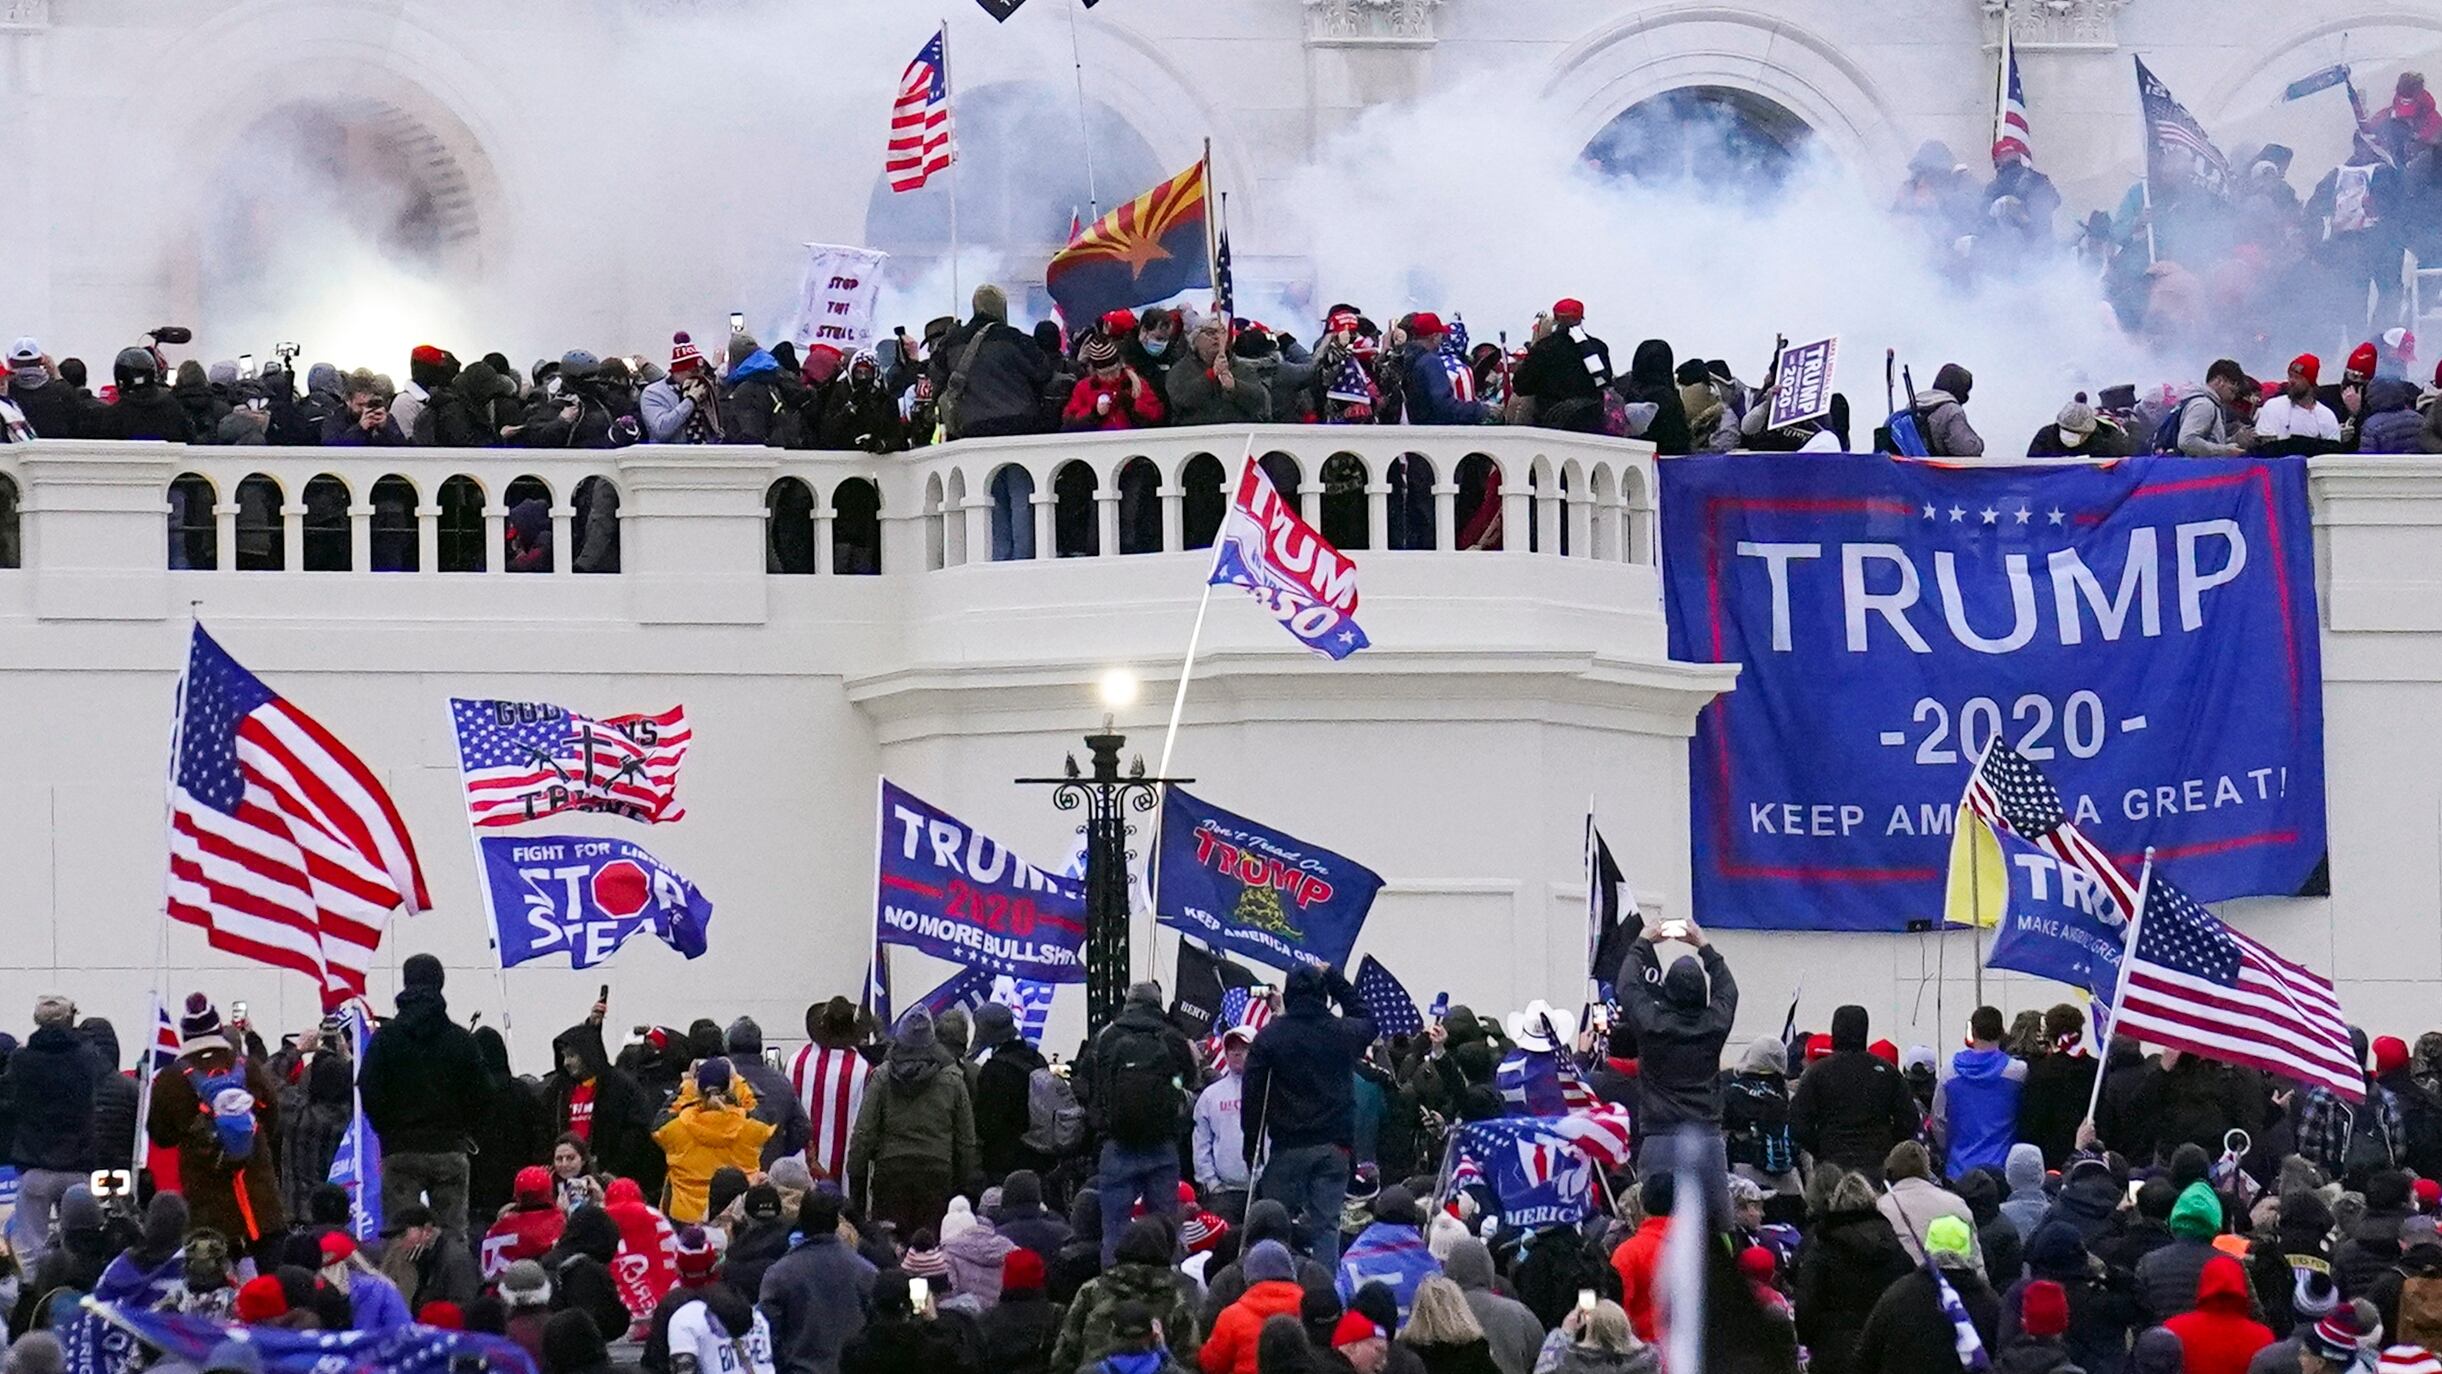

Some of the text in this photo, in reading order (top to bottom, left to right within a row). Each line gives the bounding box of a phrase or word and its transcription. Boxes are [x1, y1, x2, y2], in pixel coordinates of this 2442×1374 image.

[828, 276, 859, 291] STOP
[1779, 365, 1797, 408] 2020
[1798, 344, 1825, 414] TRUMP
[1251, 461, 1359, 611] TUM
[1736, 517, 2248, 654] TRUMP
[494, 701, 562, 727] GOD
[1750, 801, 1864, 836] KEEP
[2122, 766, 2288, 820] GREAT!
[513, 845, 564, 863] FIGHT
[573, 842, 610, 858] FOR
[894, 803, 1077, 901] TRUM
[1192, 826, 1334, 910] TRUMP
[1202, 818, 1330, 875] Don't Tread On
[2013, 853, 2128, 942] TRU
[884, 905, 918, 932] NO
[917, 914, 984, 950] MORE
[1183, 906, 1221, 931] KEEP
[1223, 928, 1292, 957] AMERICA
[2017, 914, 2059, 938] MAKE
[2091, 939, 2123, 968] GREA
